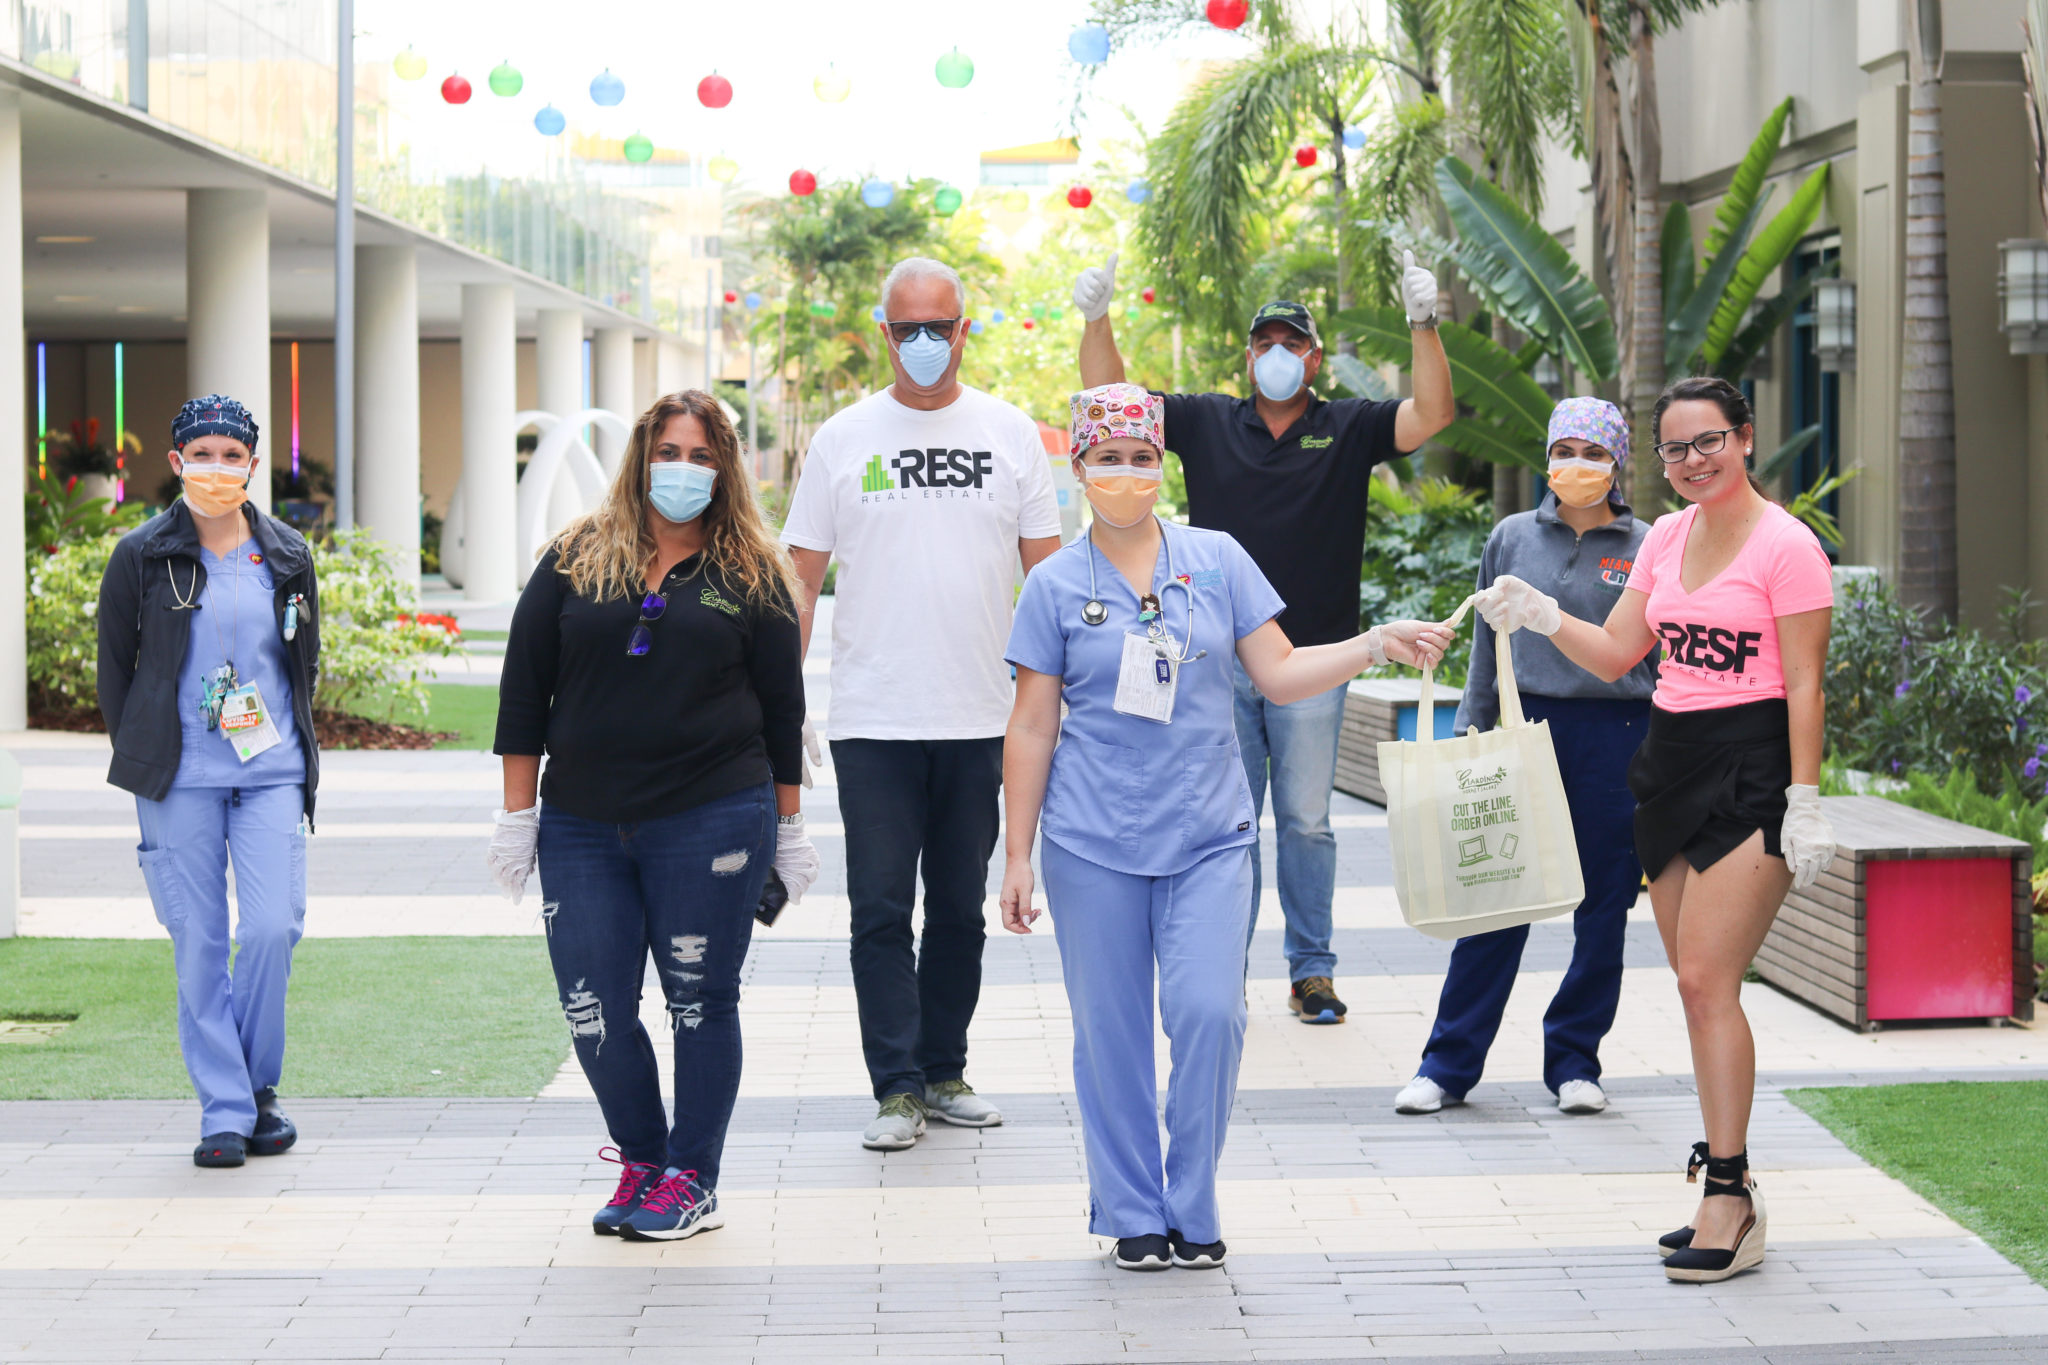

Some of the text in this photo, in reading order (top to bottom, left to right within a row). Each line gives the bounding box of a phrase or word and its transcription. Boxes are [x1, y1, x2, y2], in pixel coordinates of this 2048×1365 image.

[891, 448, 992, 488] RESF
[861, 489, 995, 504] REAL ESTATE
[1598, 557, 1633, 574] MIAM
[1656, 622, 1763, 674] RESF
[1679, 666, 1758, 687] STATE
[1453, 795, 1516, 817] CUT THE LINE.
[1451, 809, 1520, 832] ORDER ONLINE.
